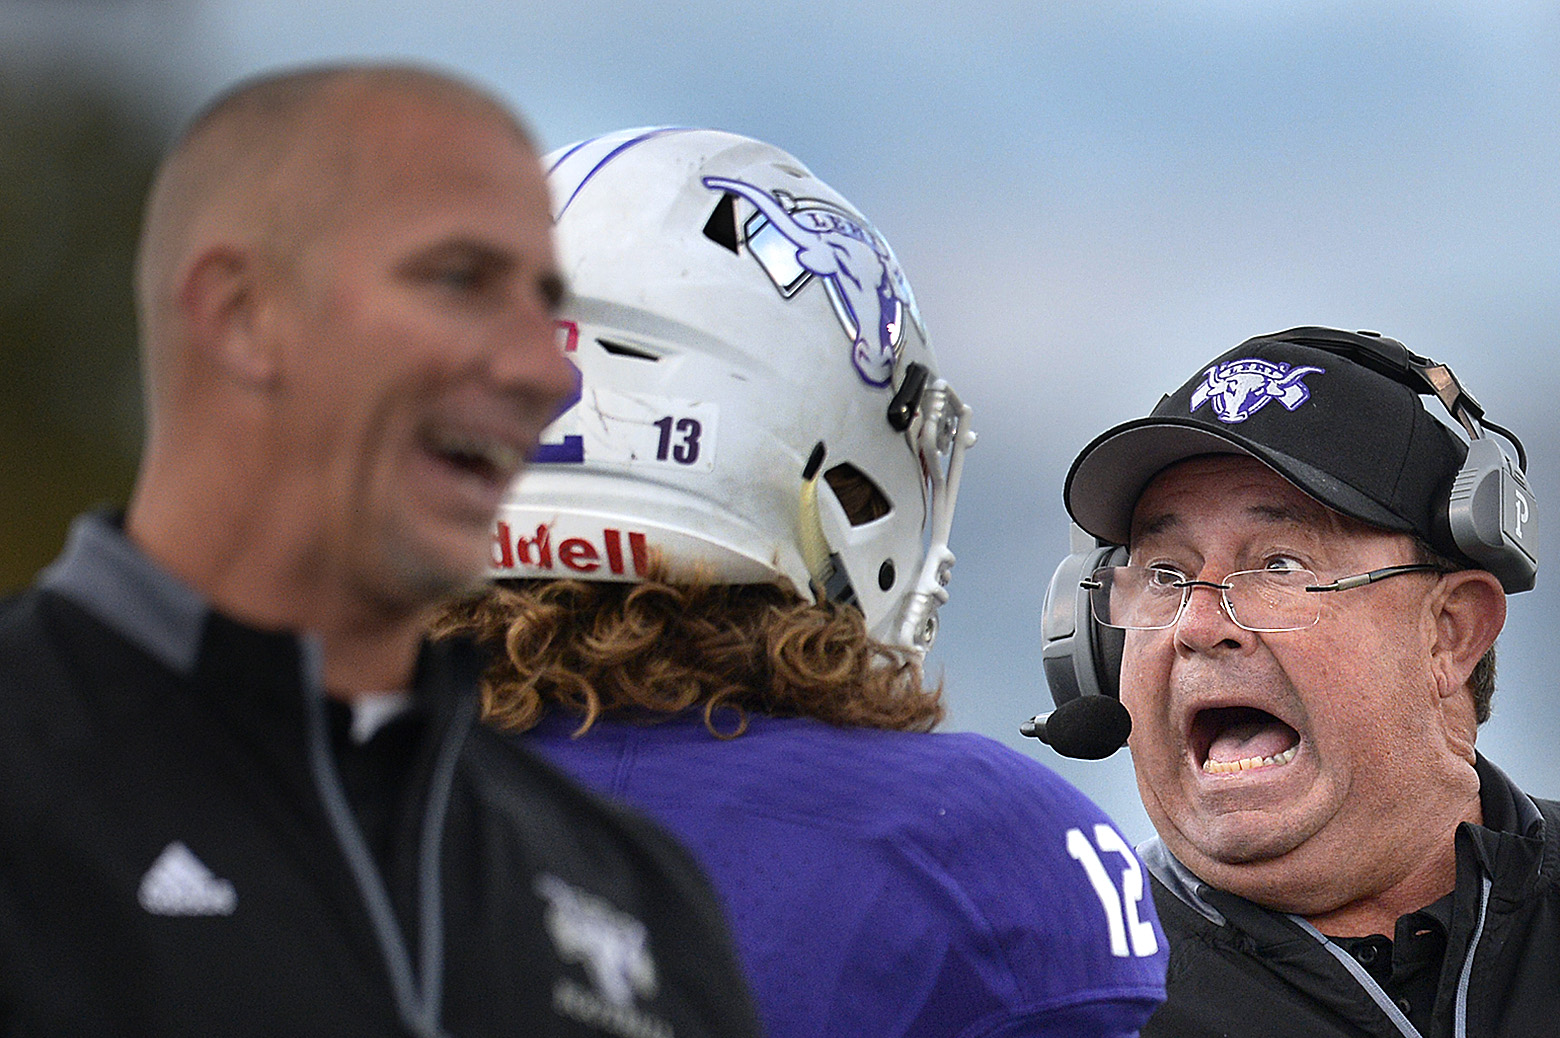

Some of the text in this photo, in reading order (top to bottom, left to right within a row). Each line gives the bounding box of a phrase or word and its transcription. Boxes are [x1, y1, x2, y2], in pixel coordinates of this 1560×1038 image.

[653, 416, 702, 466] 13
[491, 520, 649, 577] ddell
[1066, 824, 1159, 957] 12
